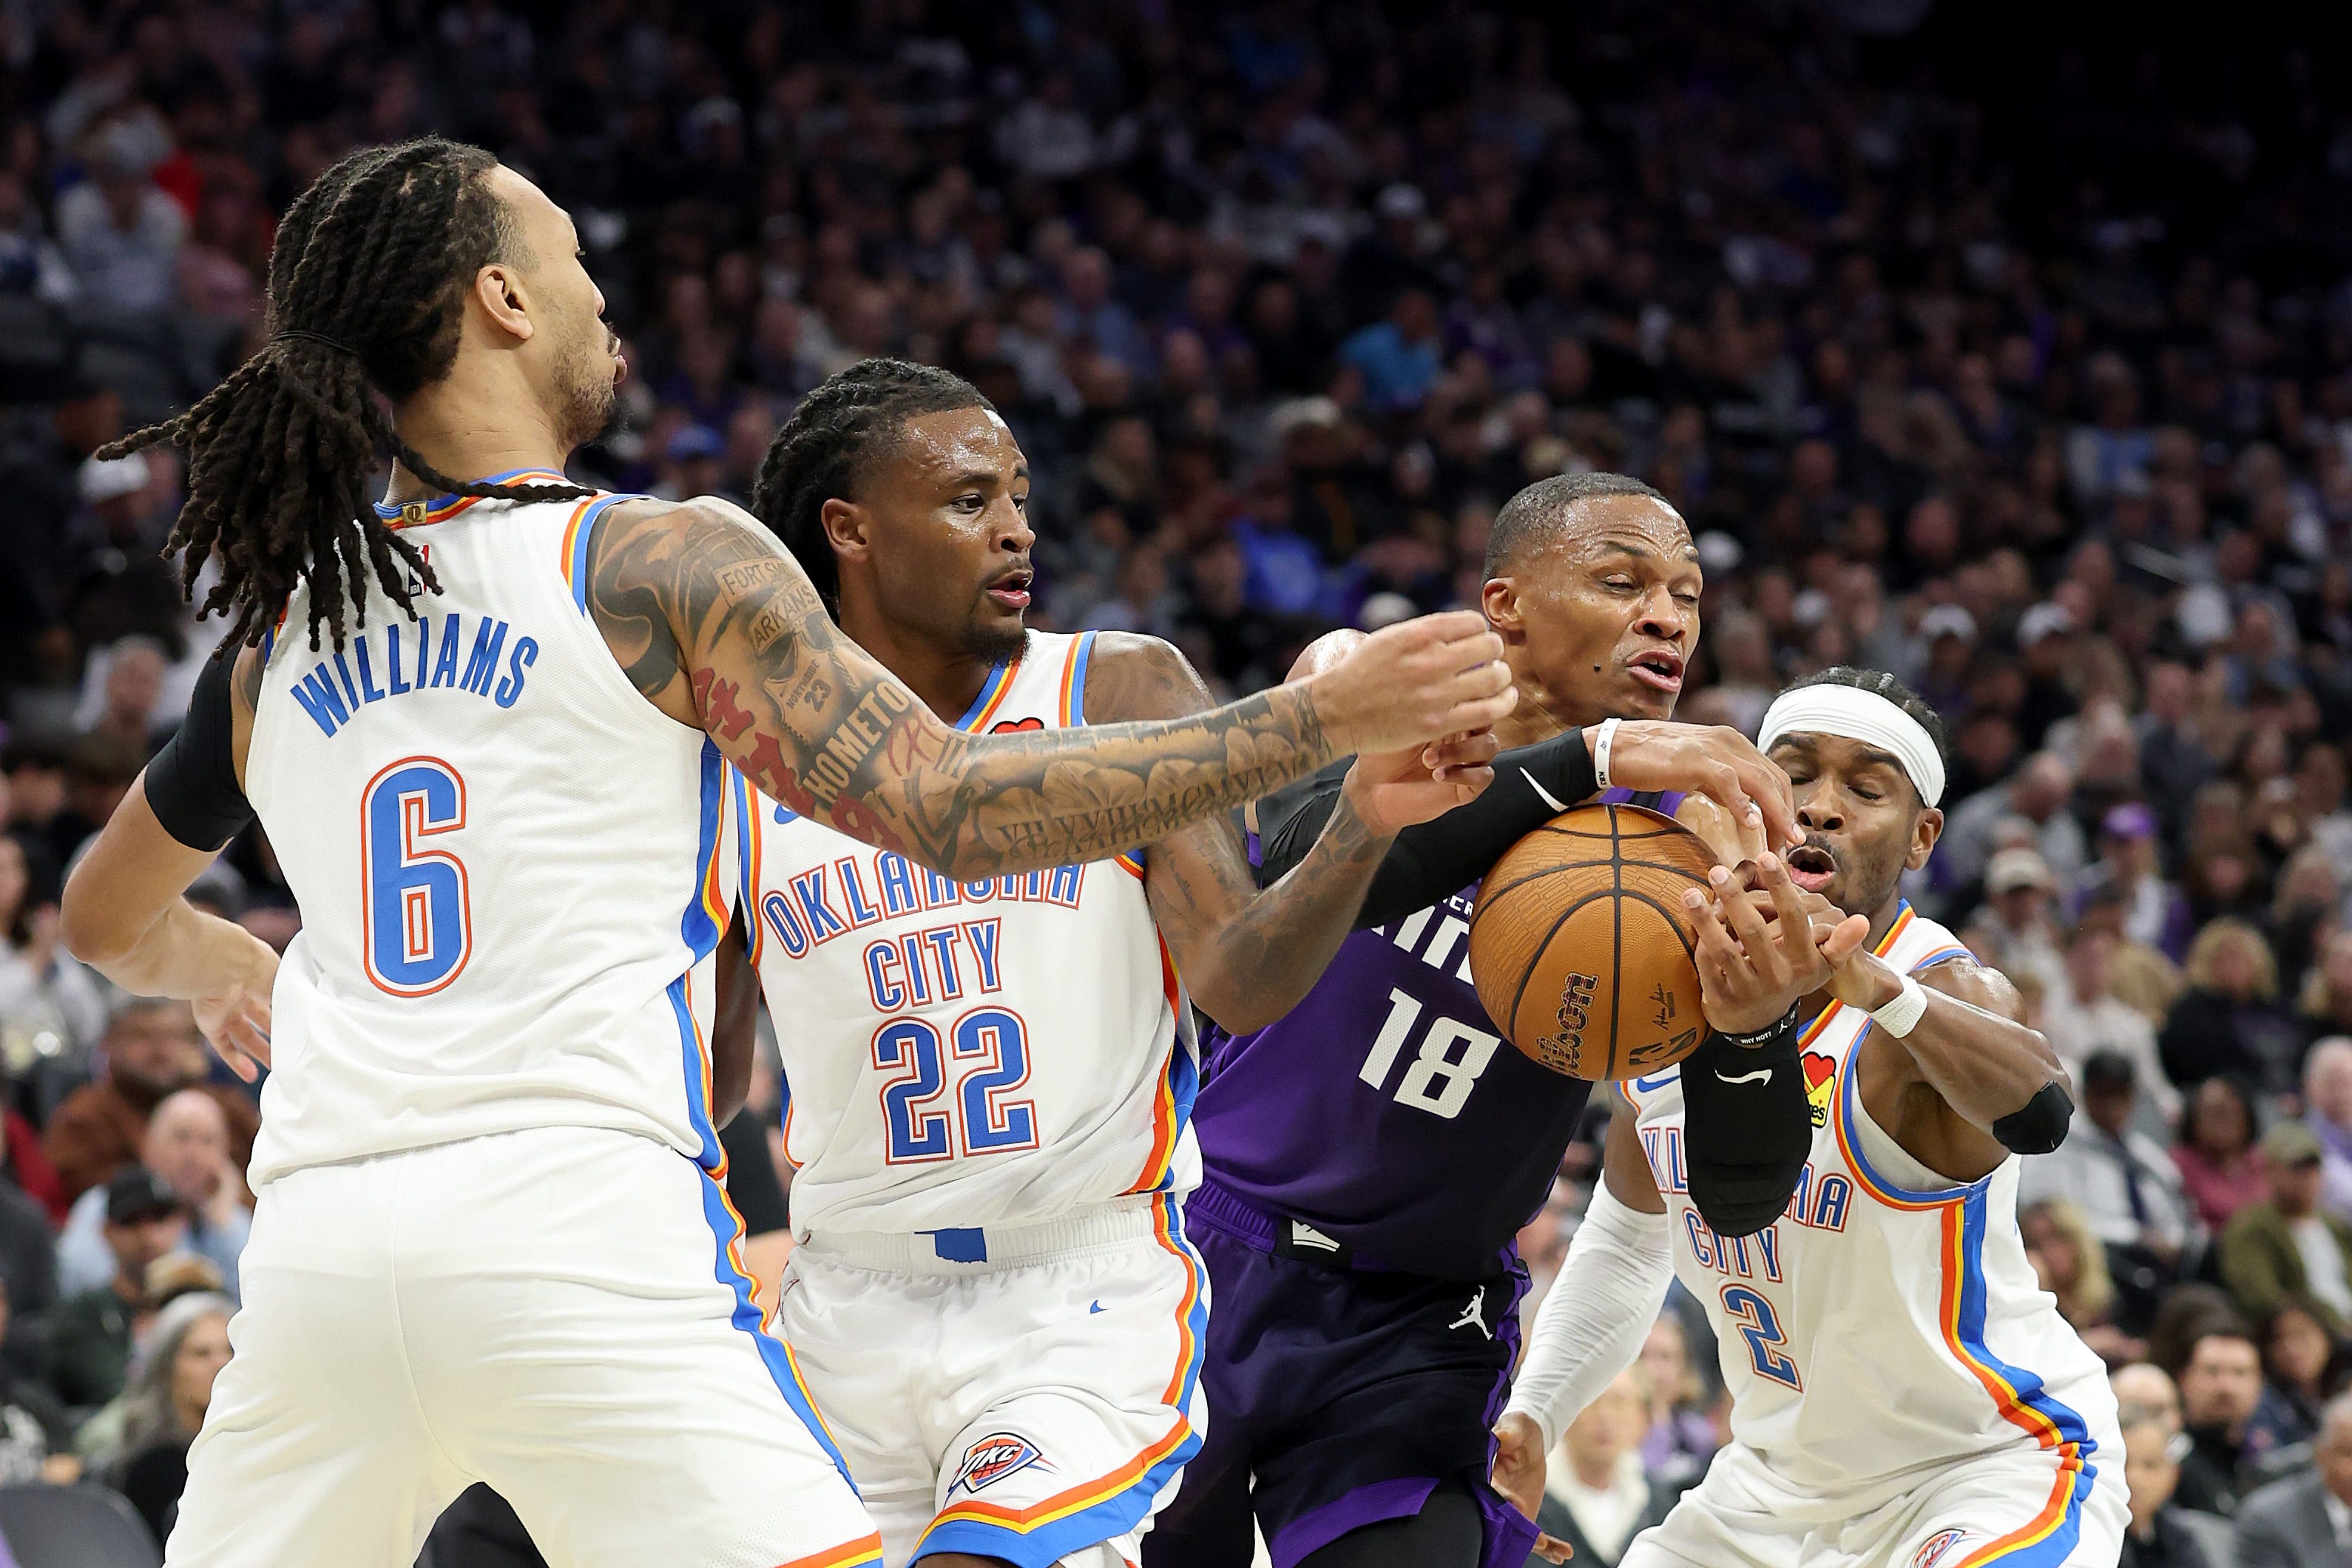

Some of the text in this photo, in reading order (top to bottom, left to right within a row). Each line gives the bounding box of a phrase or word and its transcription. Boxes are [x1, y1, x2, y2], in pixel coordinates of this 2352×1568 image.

[723, 564, 766, 596] FORT
[290, 613, 538, 737] WILLIAMS
[804, 678, 831, 712] 23
[802, 680, 910, 805] HOMETO
[361, 755, 473, 998] 6
[863, 917, 1002, 1013] CITY
[871, 1005, 1039, 1166] 22
[1358, 987, 1501, 1120] 18
[1755, 1030, 1772, 1042] NOT?
[1720, 1283, 1803, 1393] 2
[950, 1445, 1021, 1487] OKC
